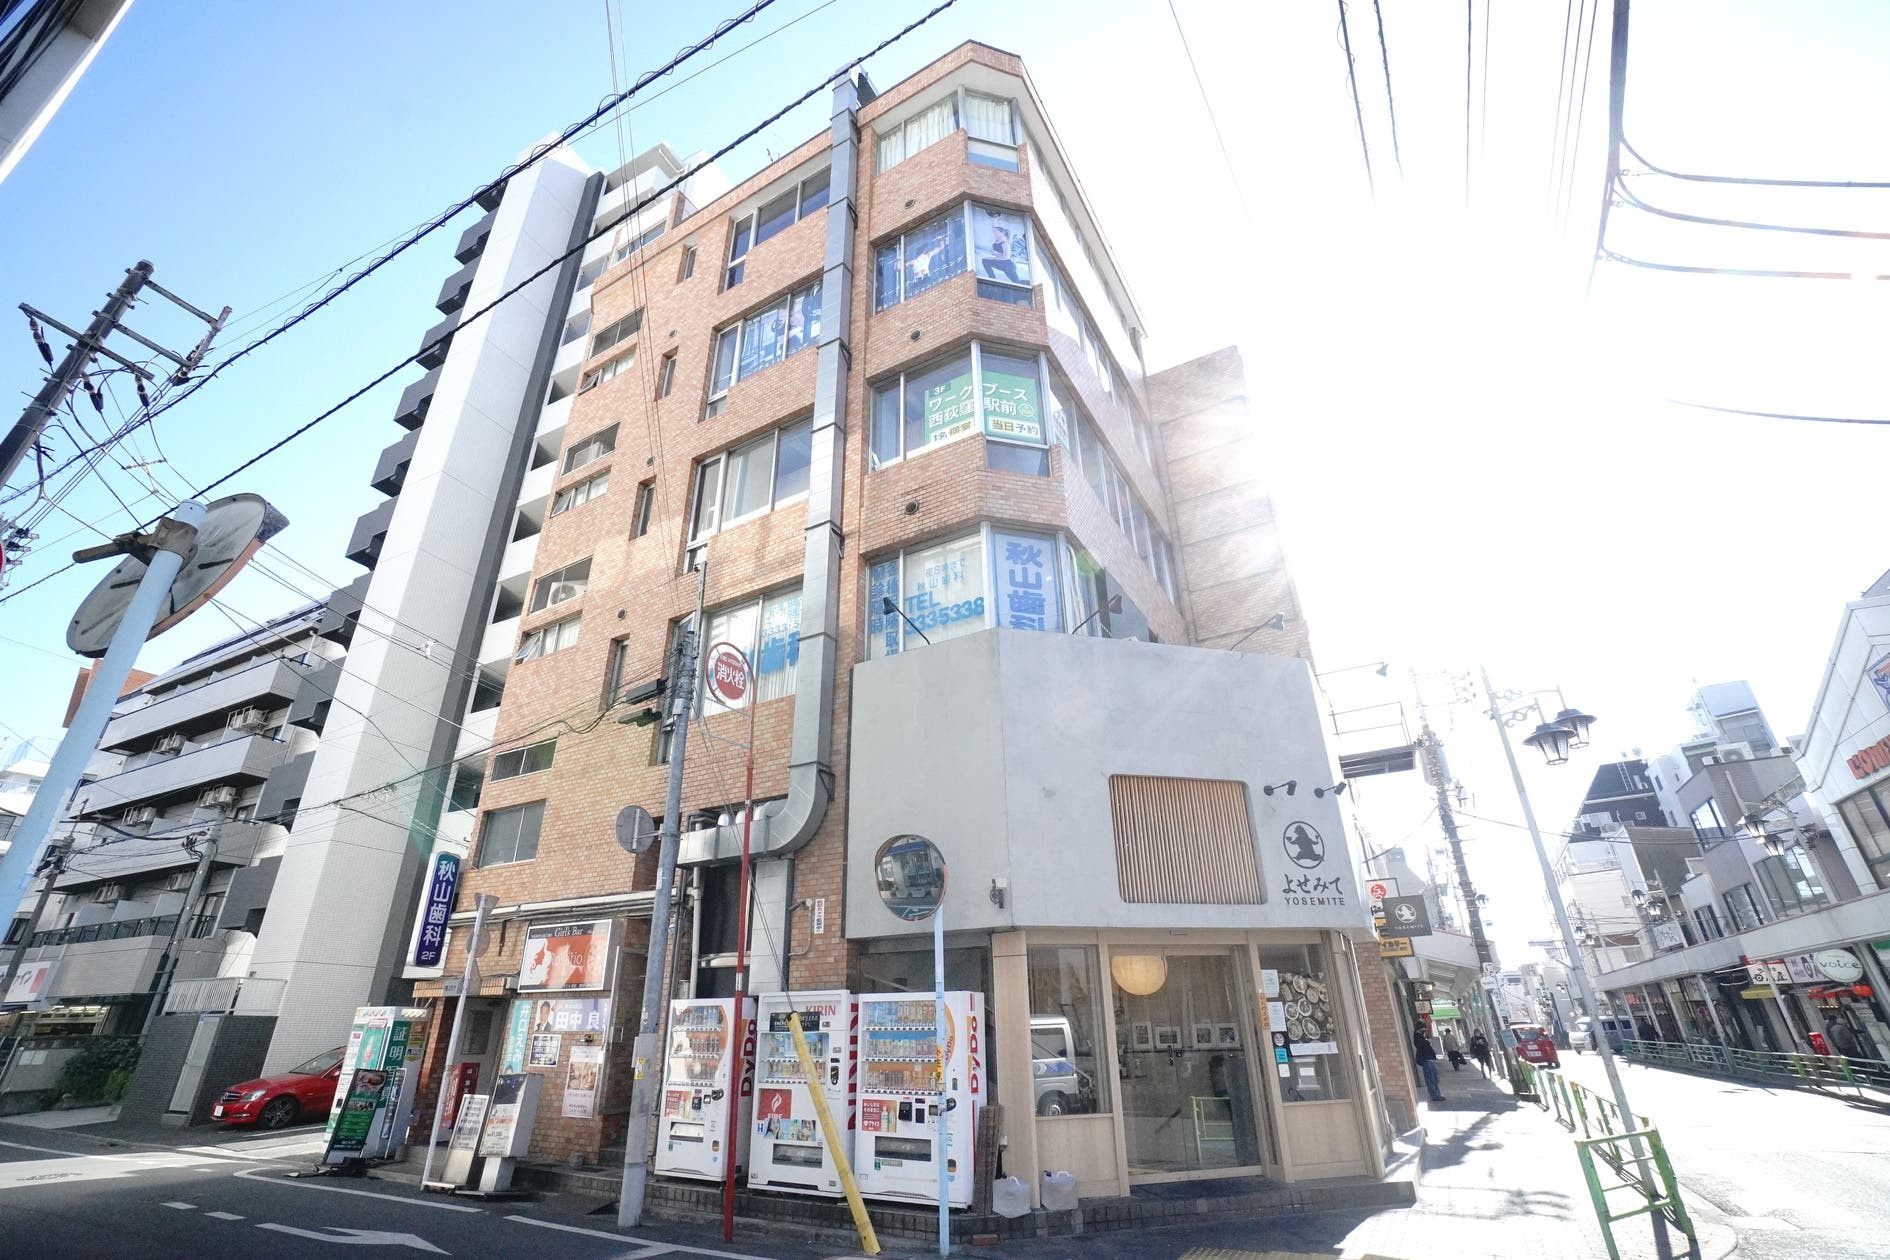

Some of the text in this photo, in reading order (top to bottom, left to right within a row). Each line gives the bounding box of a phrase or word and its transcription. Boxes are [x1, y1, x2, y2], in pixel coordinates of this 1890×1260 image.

[934, 385, 945, 396] 3F
[983, 397, 1017, 416] 駅前
[991, 418, 1039, 437] 当日予約
[905, 591, 941, 614] TEL
[717, 661, 745, 690] 消火栓
[1282, 874, 1344, 896] よせみて
[423, 860, 456, 947] 秋山歯科
[1284, 896, 1345, 906] YOSEMITE
[421, 951, 436, 961] 2F
[1819, 959, 1860, 969] voice
[805, 1004, 837, 1017] KIRIN
